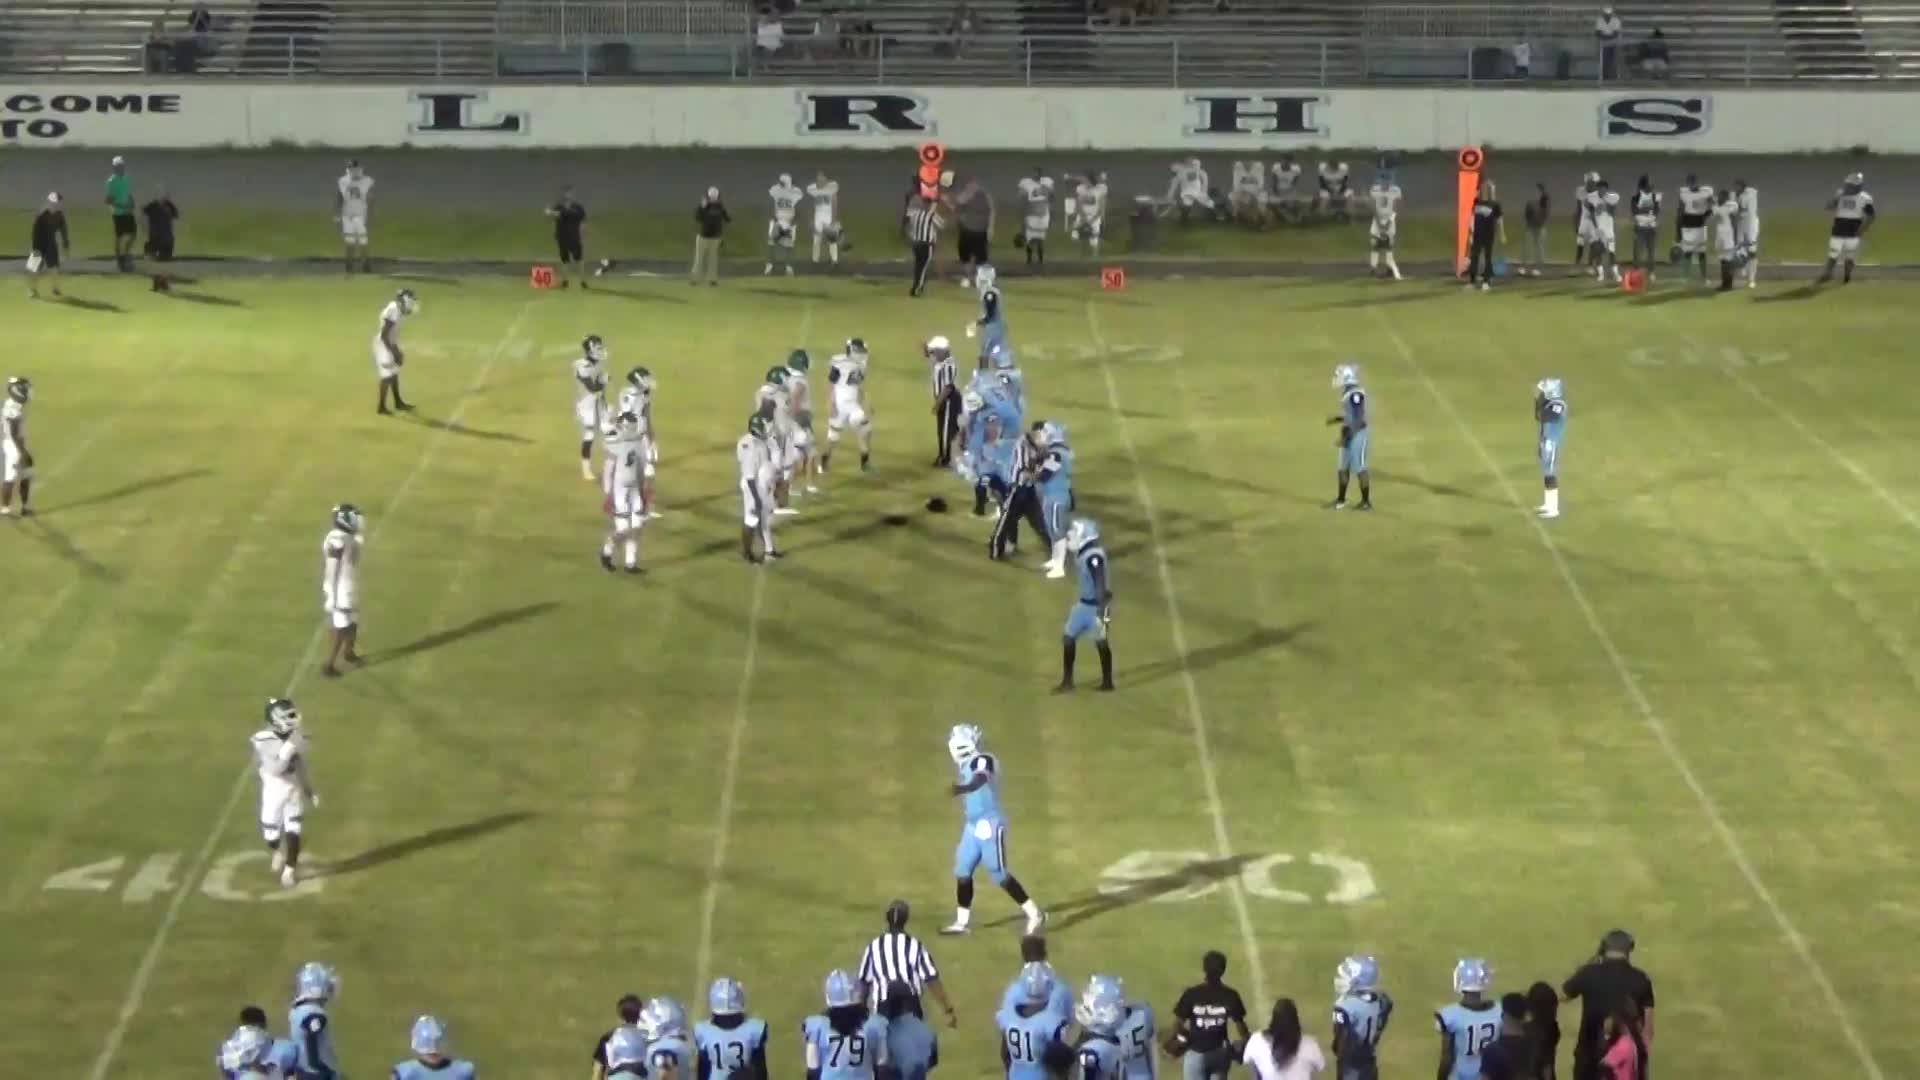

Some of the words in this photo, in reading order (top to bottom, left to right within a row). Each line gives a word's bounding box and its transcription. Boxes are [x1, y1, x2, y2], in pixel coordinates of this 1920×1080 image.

[0, 94, 181, 113] COME
[0, 118, 69, 138] TO
[42, 850, 324, 903] 40
[1097, 850, 1377, 903] 50
[828, 1033, 866, 1068] 79
[1008, 1027, 1035, 1063] 91
[1465, 1022, 1496, 1056] 12
[713, 1041, 746, 1072] 13
